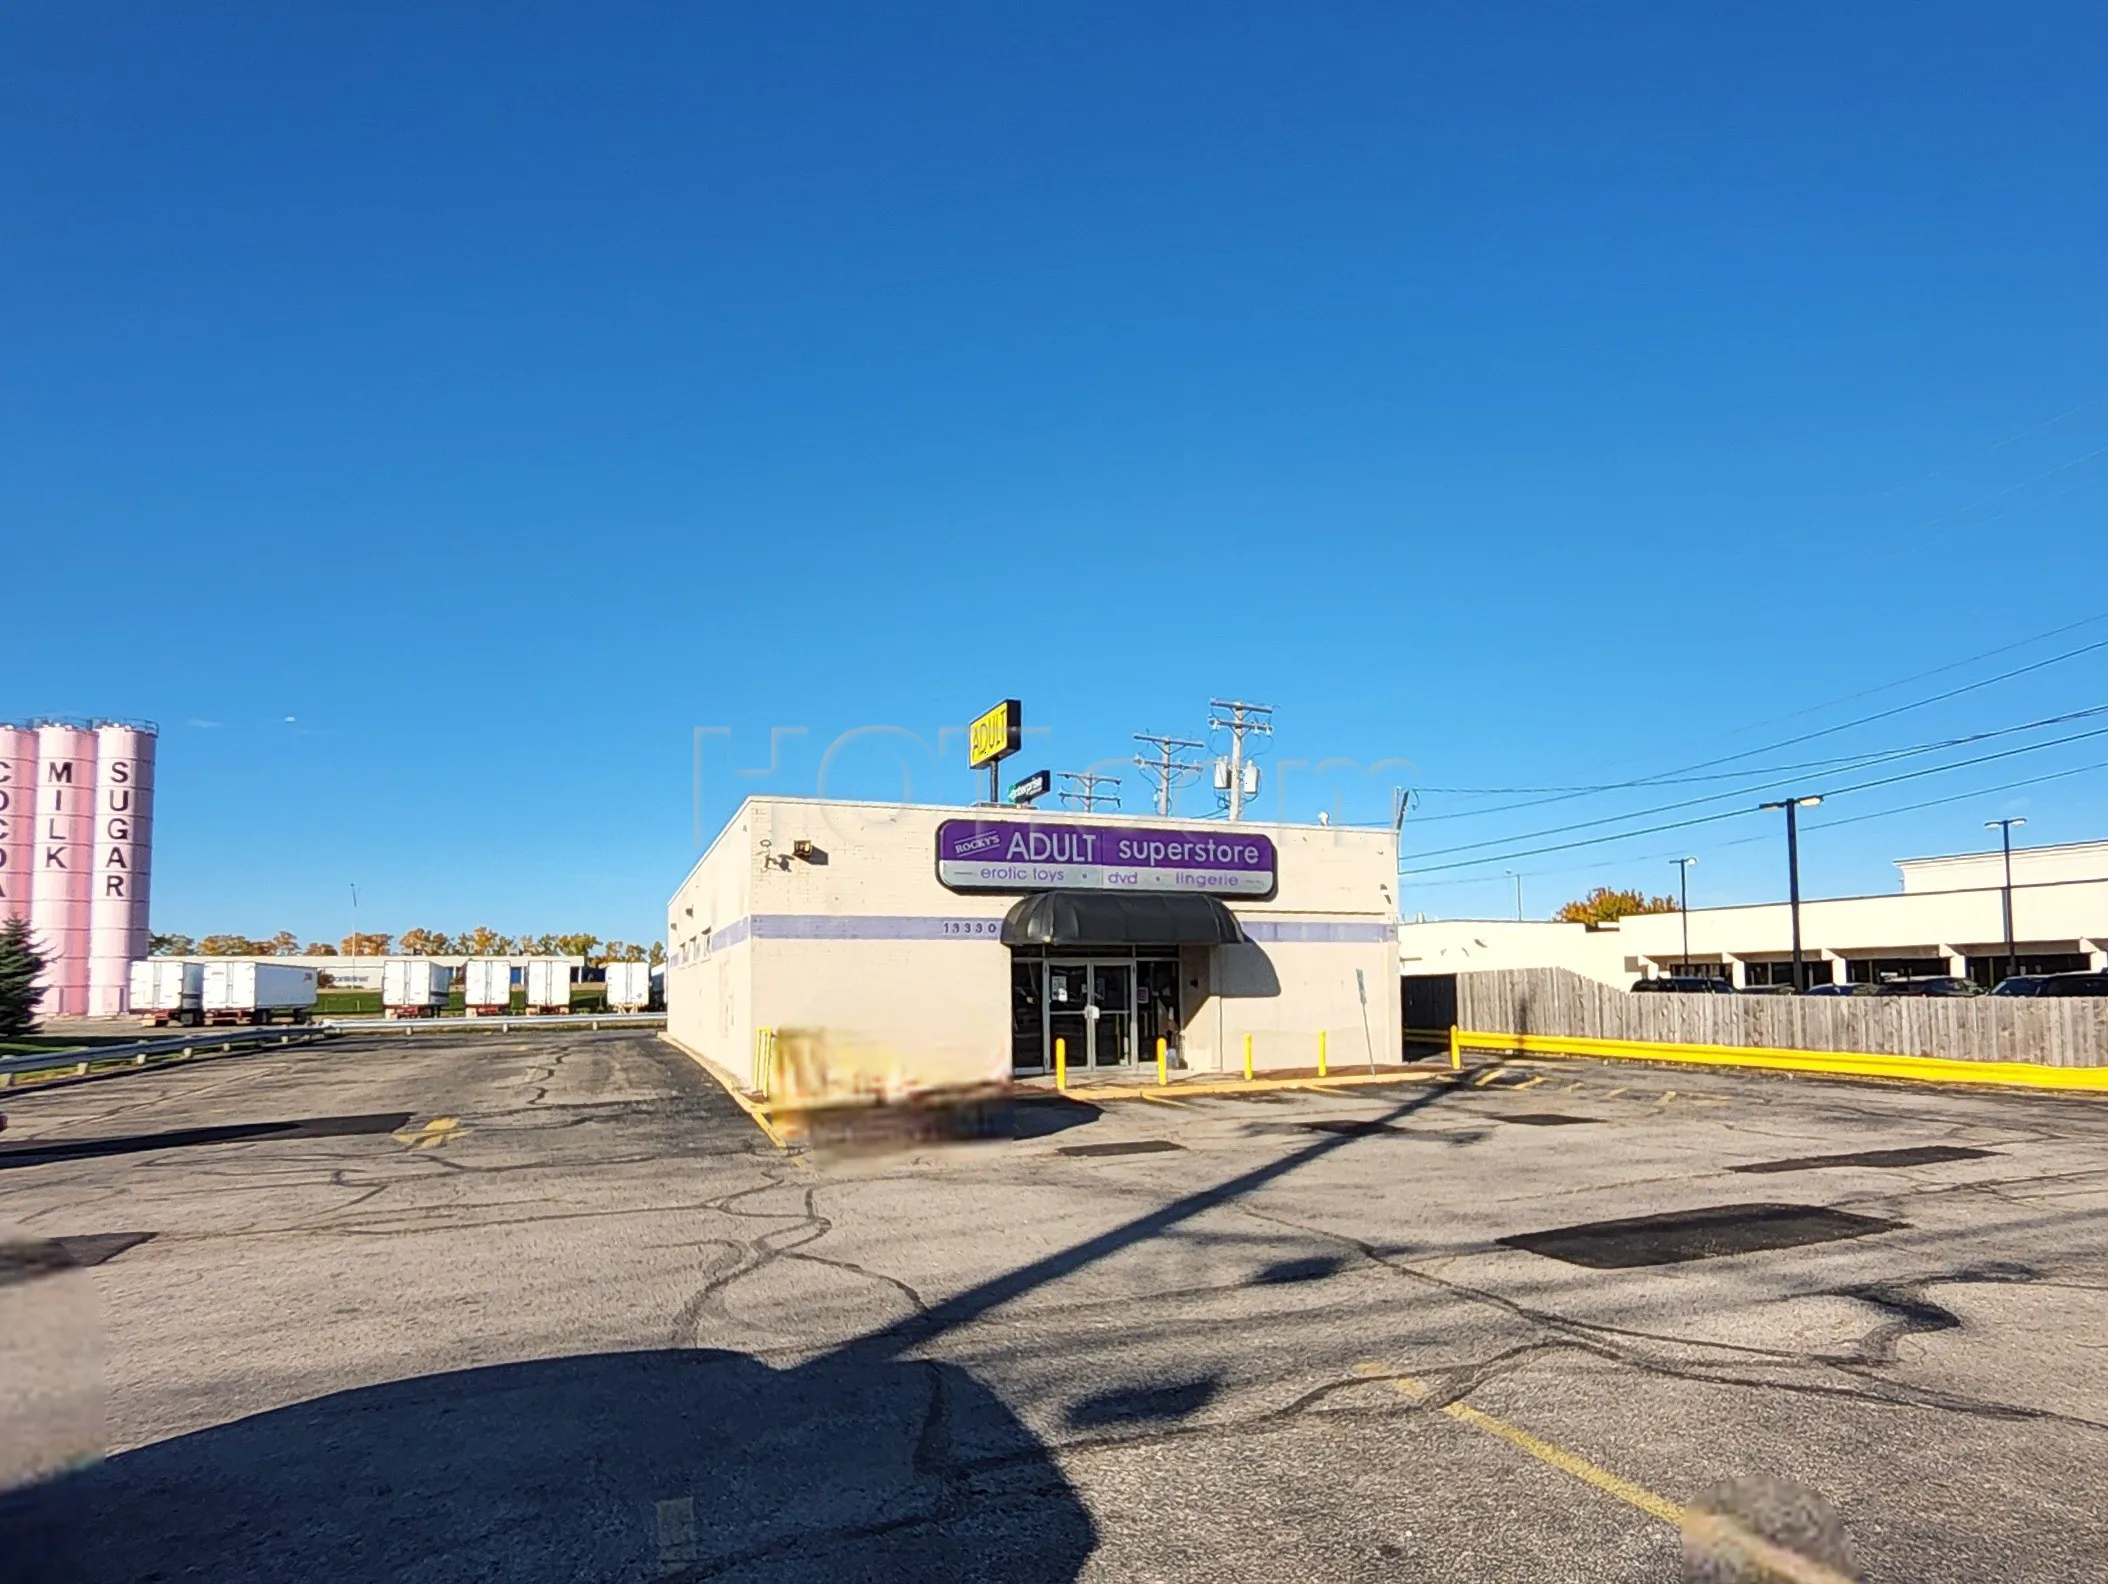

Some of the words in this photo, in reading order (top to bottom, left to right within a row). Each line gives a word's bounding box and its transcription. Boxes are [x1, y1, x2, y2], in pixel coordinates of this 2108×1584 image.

[972, 709, 1006, 762] ADULT
[46, 762, 73, 868] MILK
[105, 761, 129, 897] SUGAR
[955, 834, 1000, 854] ROCKY'S
[1006, 831, 1096, 862] ADULT
[1118, 838, 1259, 866] superstore
[980, 866, 1028, 881] erotic
[1033, 868, 1064, 883] toys
[1108, 872, 1138, 885] dvd
[1176, 873, 1238, 888] lingerie
[943, 922, 997, 934] 13330
